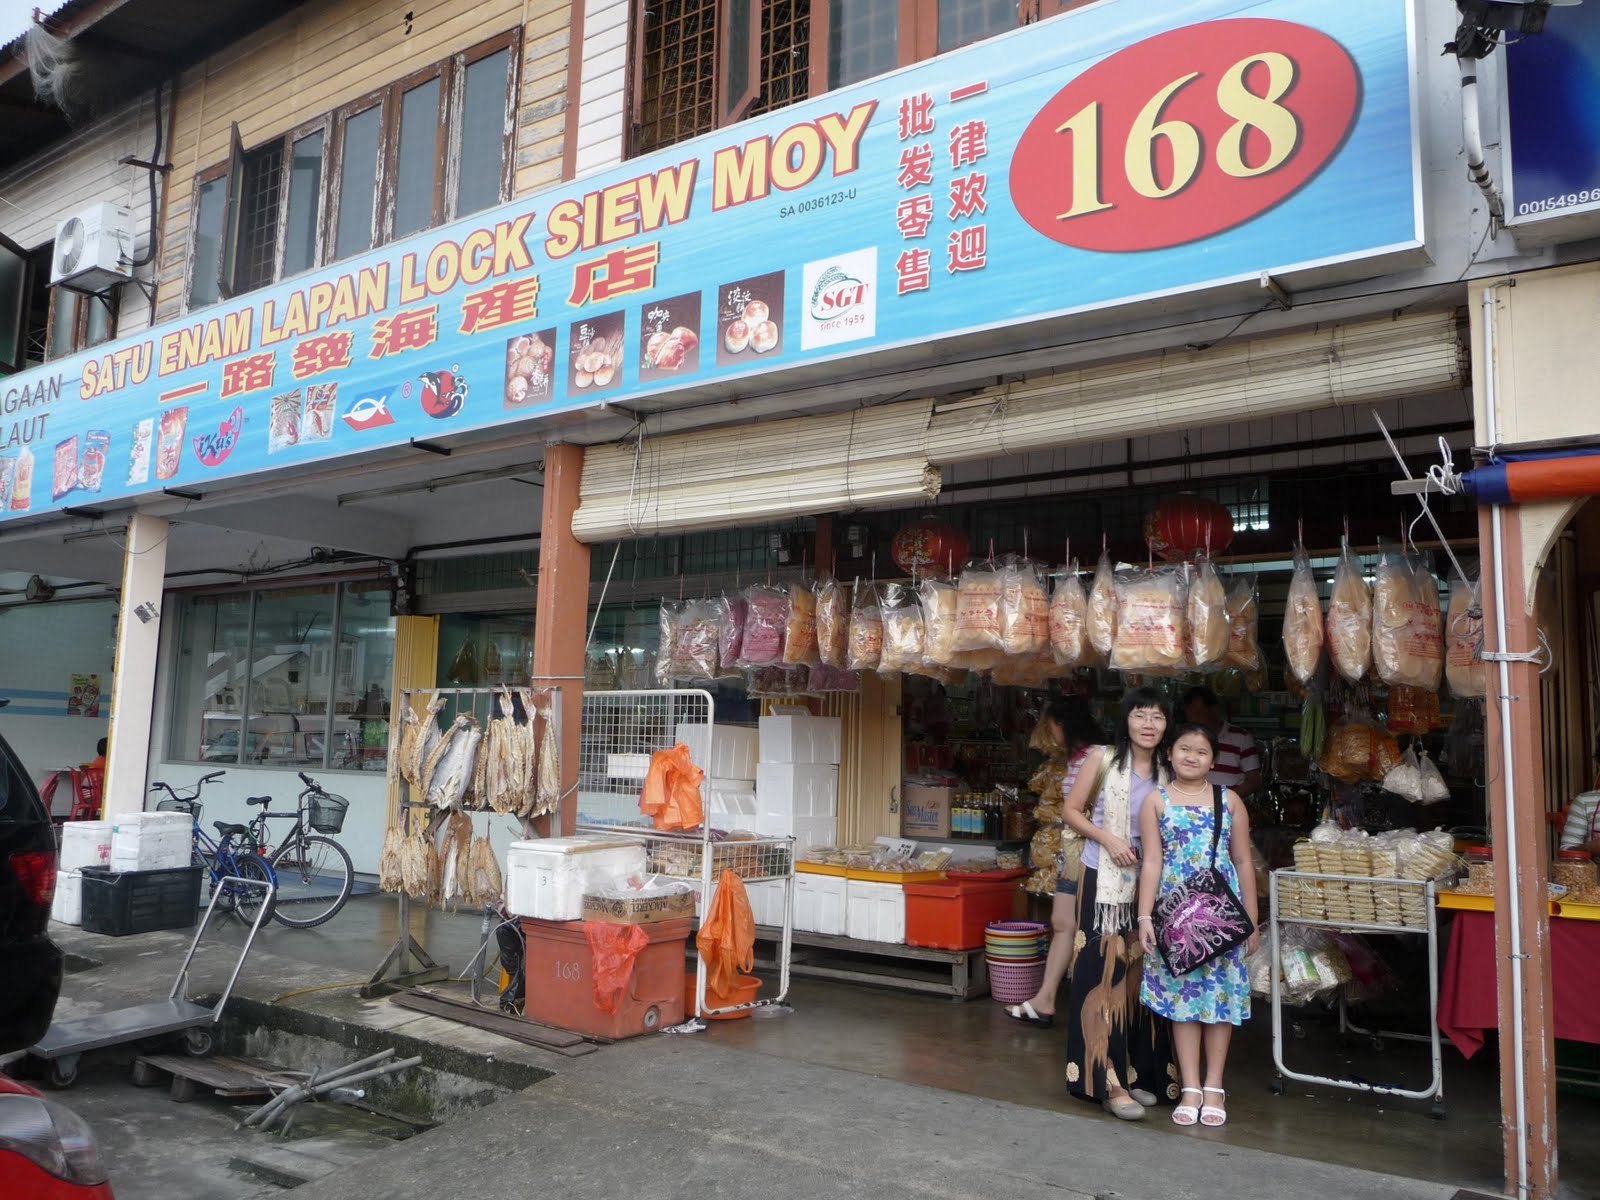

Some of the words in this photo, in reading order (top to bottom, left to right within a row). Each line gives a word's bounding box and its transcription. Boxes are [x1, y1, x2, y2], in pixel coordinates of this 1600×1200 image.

[1055, 51, 1299, 220] 168
[896, 91, 936, 295] 批发零售
[947, 80, 988, 274] 一律欢迎
[779, 206, 796, 219] SA
[797, 187, 858, 214] 0036123-U
[80, 340, 154, 400] SATU
[158, 307, 252, 377] ENAM
[260, 261, 391, 346] LAPAN
[399, 211, 537, 305] LOCK
[544, 158, 702, 260] SIEW
[711, 99, 878, 212] MOY
[821, 283, 868, 312] SGT
[820, 320, 842, 331] since
[844, 313, 865, 327] 1959
[0, 373, 62, 416] GAAN
[554, 959, 581, 981] 168
